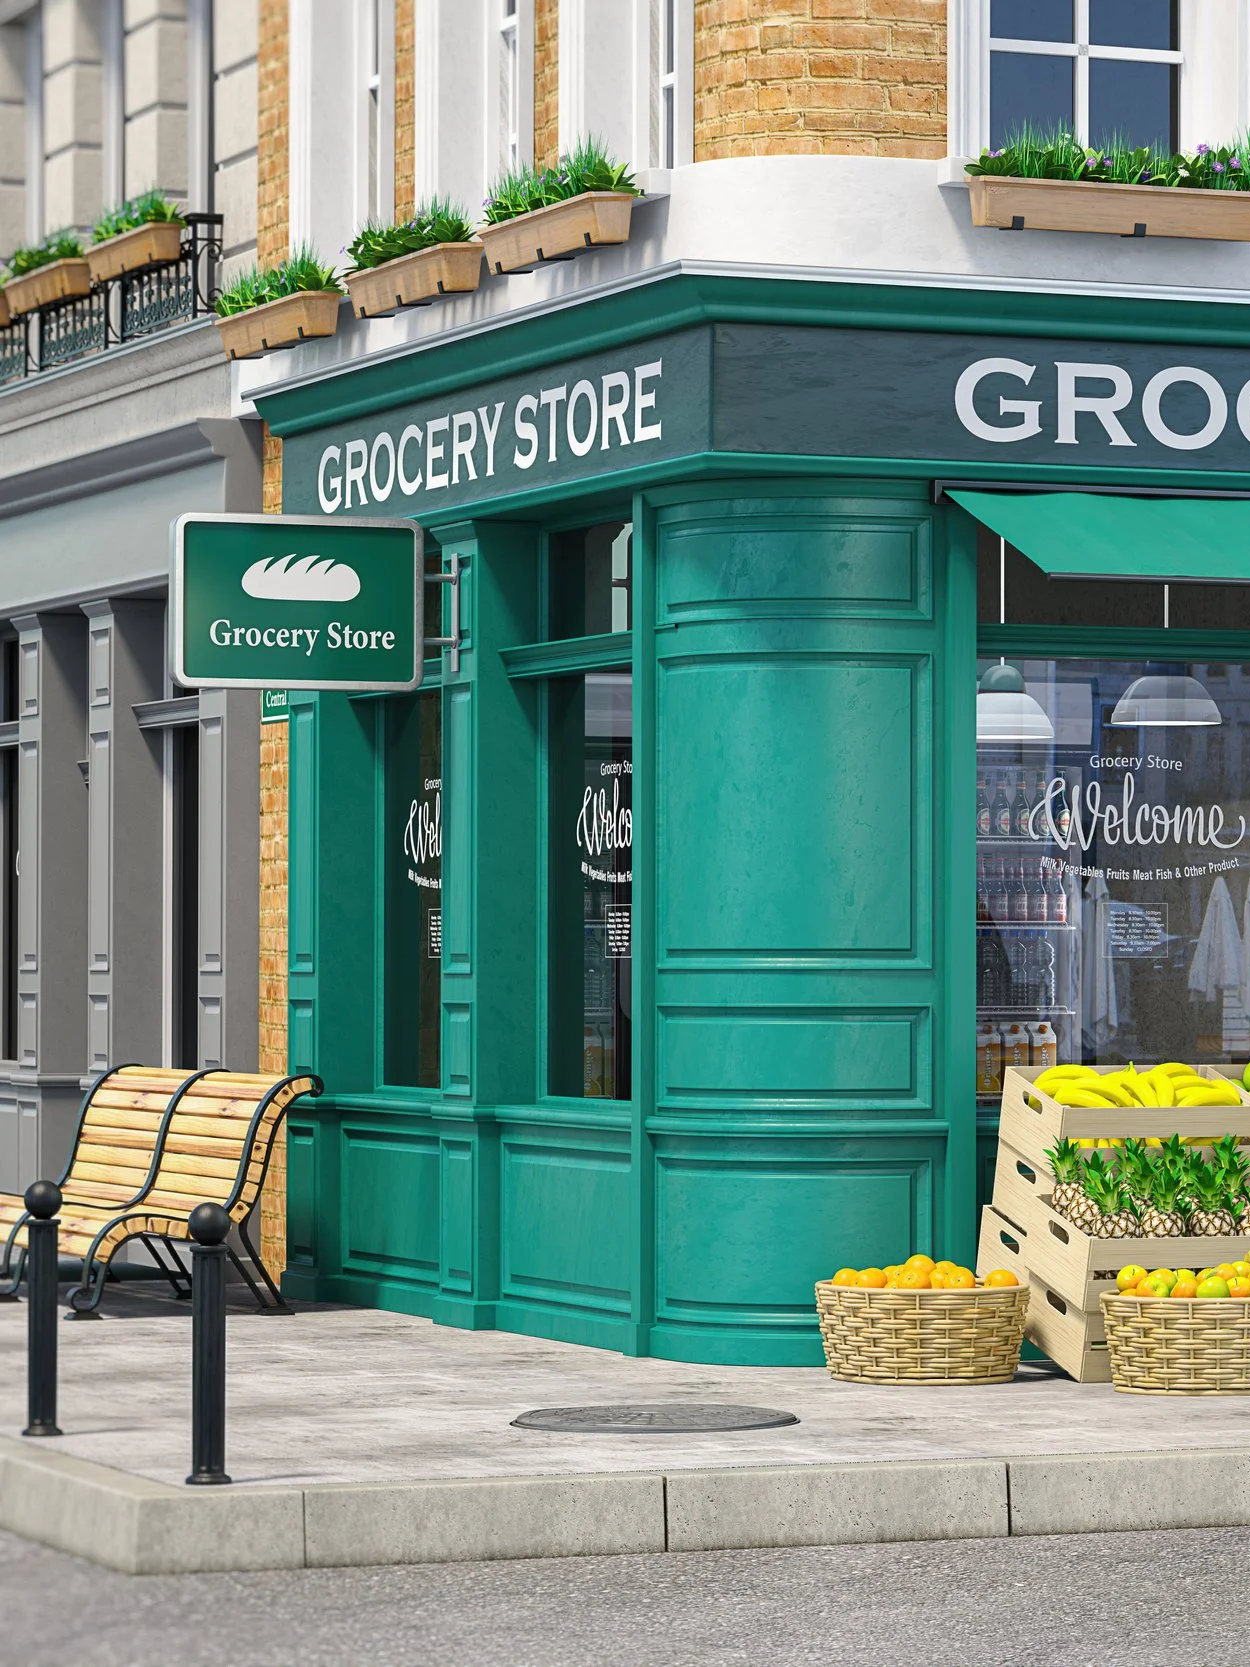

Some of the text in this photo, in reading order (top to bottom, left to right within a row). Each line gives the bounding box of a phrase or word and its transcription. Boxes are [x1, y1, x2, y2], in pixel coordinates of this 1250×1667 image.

[317, 357, 662, 514] GROCERY STORE
[209, 619, 396, 656] Grocery Store
[266, 690, 287, 708] Central
[600, 763, 622, 776] Grocery
[1090, 755, 1183, 771] Grocery Store
[1028, 772, 1246, 851] Welcome
[1040, 855, 1239, 880] Milk Vegetables Fruits Meat Fish & Other Product
